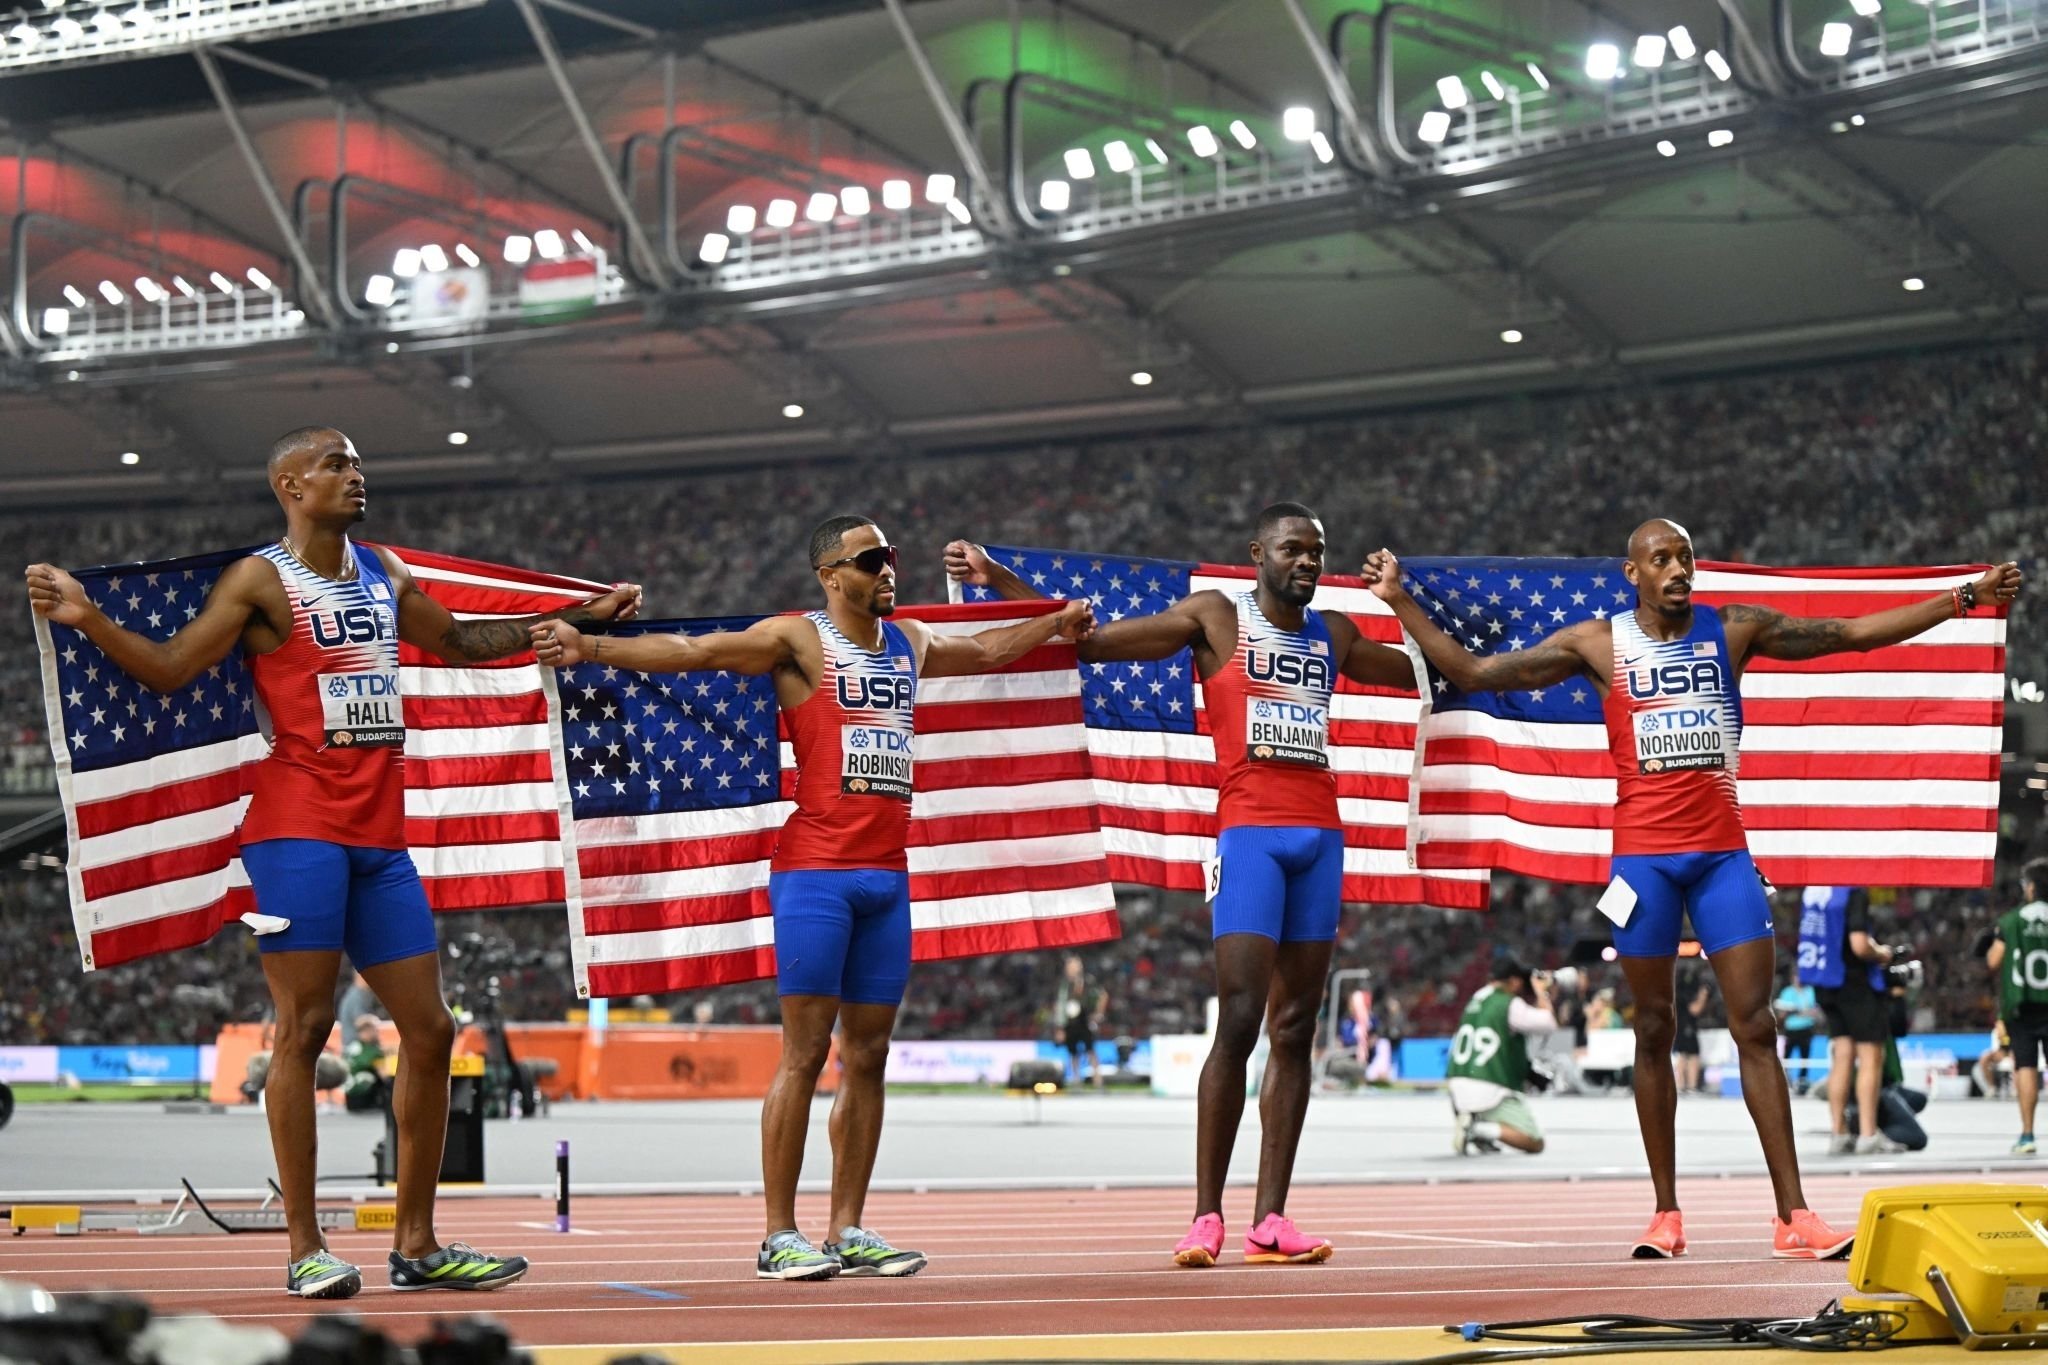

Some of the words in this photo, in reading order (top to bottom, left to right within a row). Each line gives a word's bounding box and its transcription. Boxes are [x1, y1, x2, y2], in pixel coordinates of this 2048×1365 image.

[309, 604, 396, 648] USA
[1246, 649, 1329, 691] USA
[1627, 660, 1722, 699] USA
[347, 674, 398, 696] TDK
[837, 674, 913, 711] USA
[346, 702, 394, 725] HALL
[1271, 703, 1323, 726] TDK
[1658, 708, 1718, 730] TDK
[355, 732, 397, 742] BUDAPEST
[869, 730, 912, 754] TDK
[1640, 731, 1721, 756] NORWOOD
[848, 753, 910, 780] ROBINSON
[1275, 749, 1317, 762] BUDAPEST
[1665, 757, 1712, 768] BUDAPEST
[1211, 864, 1219, 892] 8
